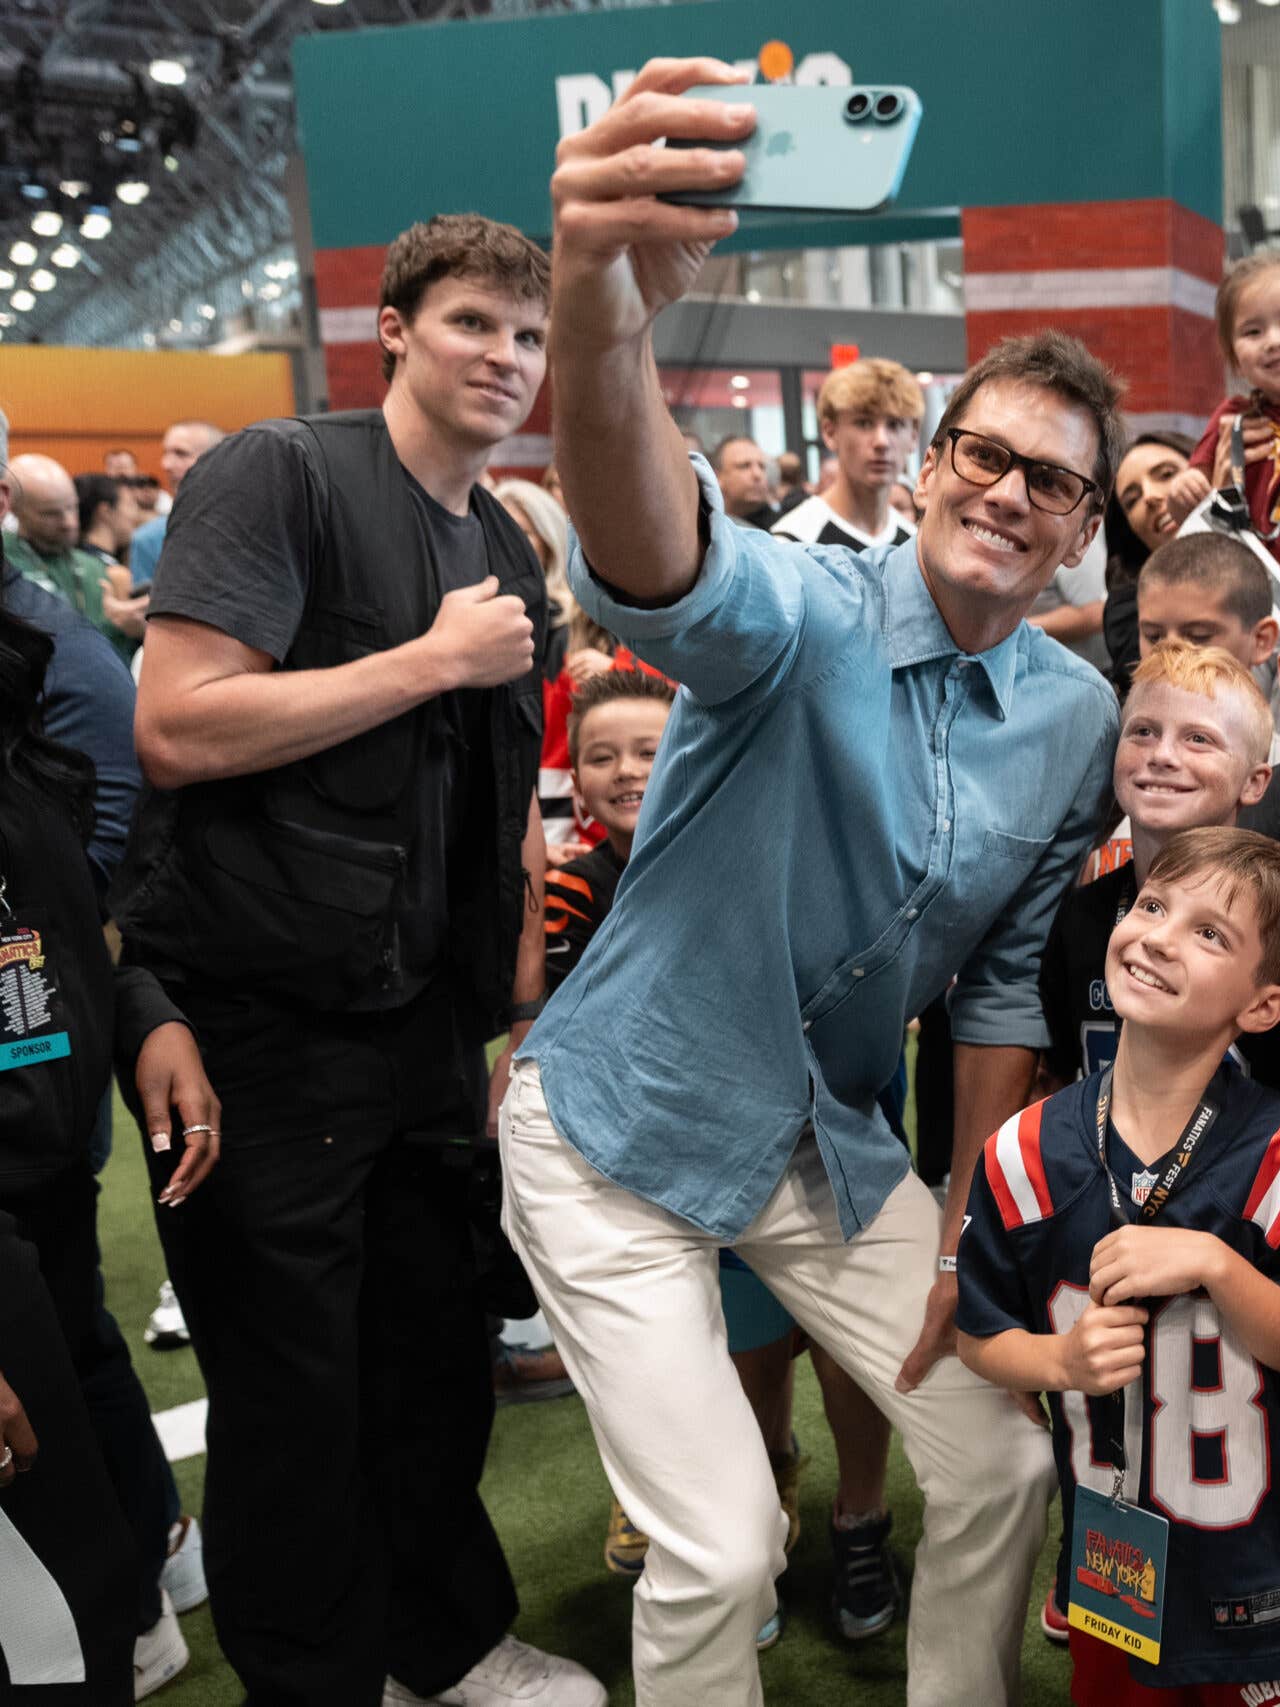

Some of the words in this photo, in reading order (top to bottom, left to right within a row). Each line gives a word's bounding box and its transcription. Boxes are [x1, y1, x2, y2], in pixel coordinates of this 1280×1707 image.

[10, 1041, 52, 1060] SPONSOR
[1183, 1106, 1213, 1152] FANATICS
[1162, 1163, 1181, 1189] FEST
[1135, 1188, 1152, 1203] NF
[1144, 1186, 1169, 1217] NYC
[1086, 1550, 1114, 1579] NEW
[1115, 1559, 1145, 1596] YORK
[1084, 1614, 1121, 1640] FRIDAY
[1124, 1635, 1142, 1650] KID
